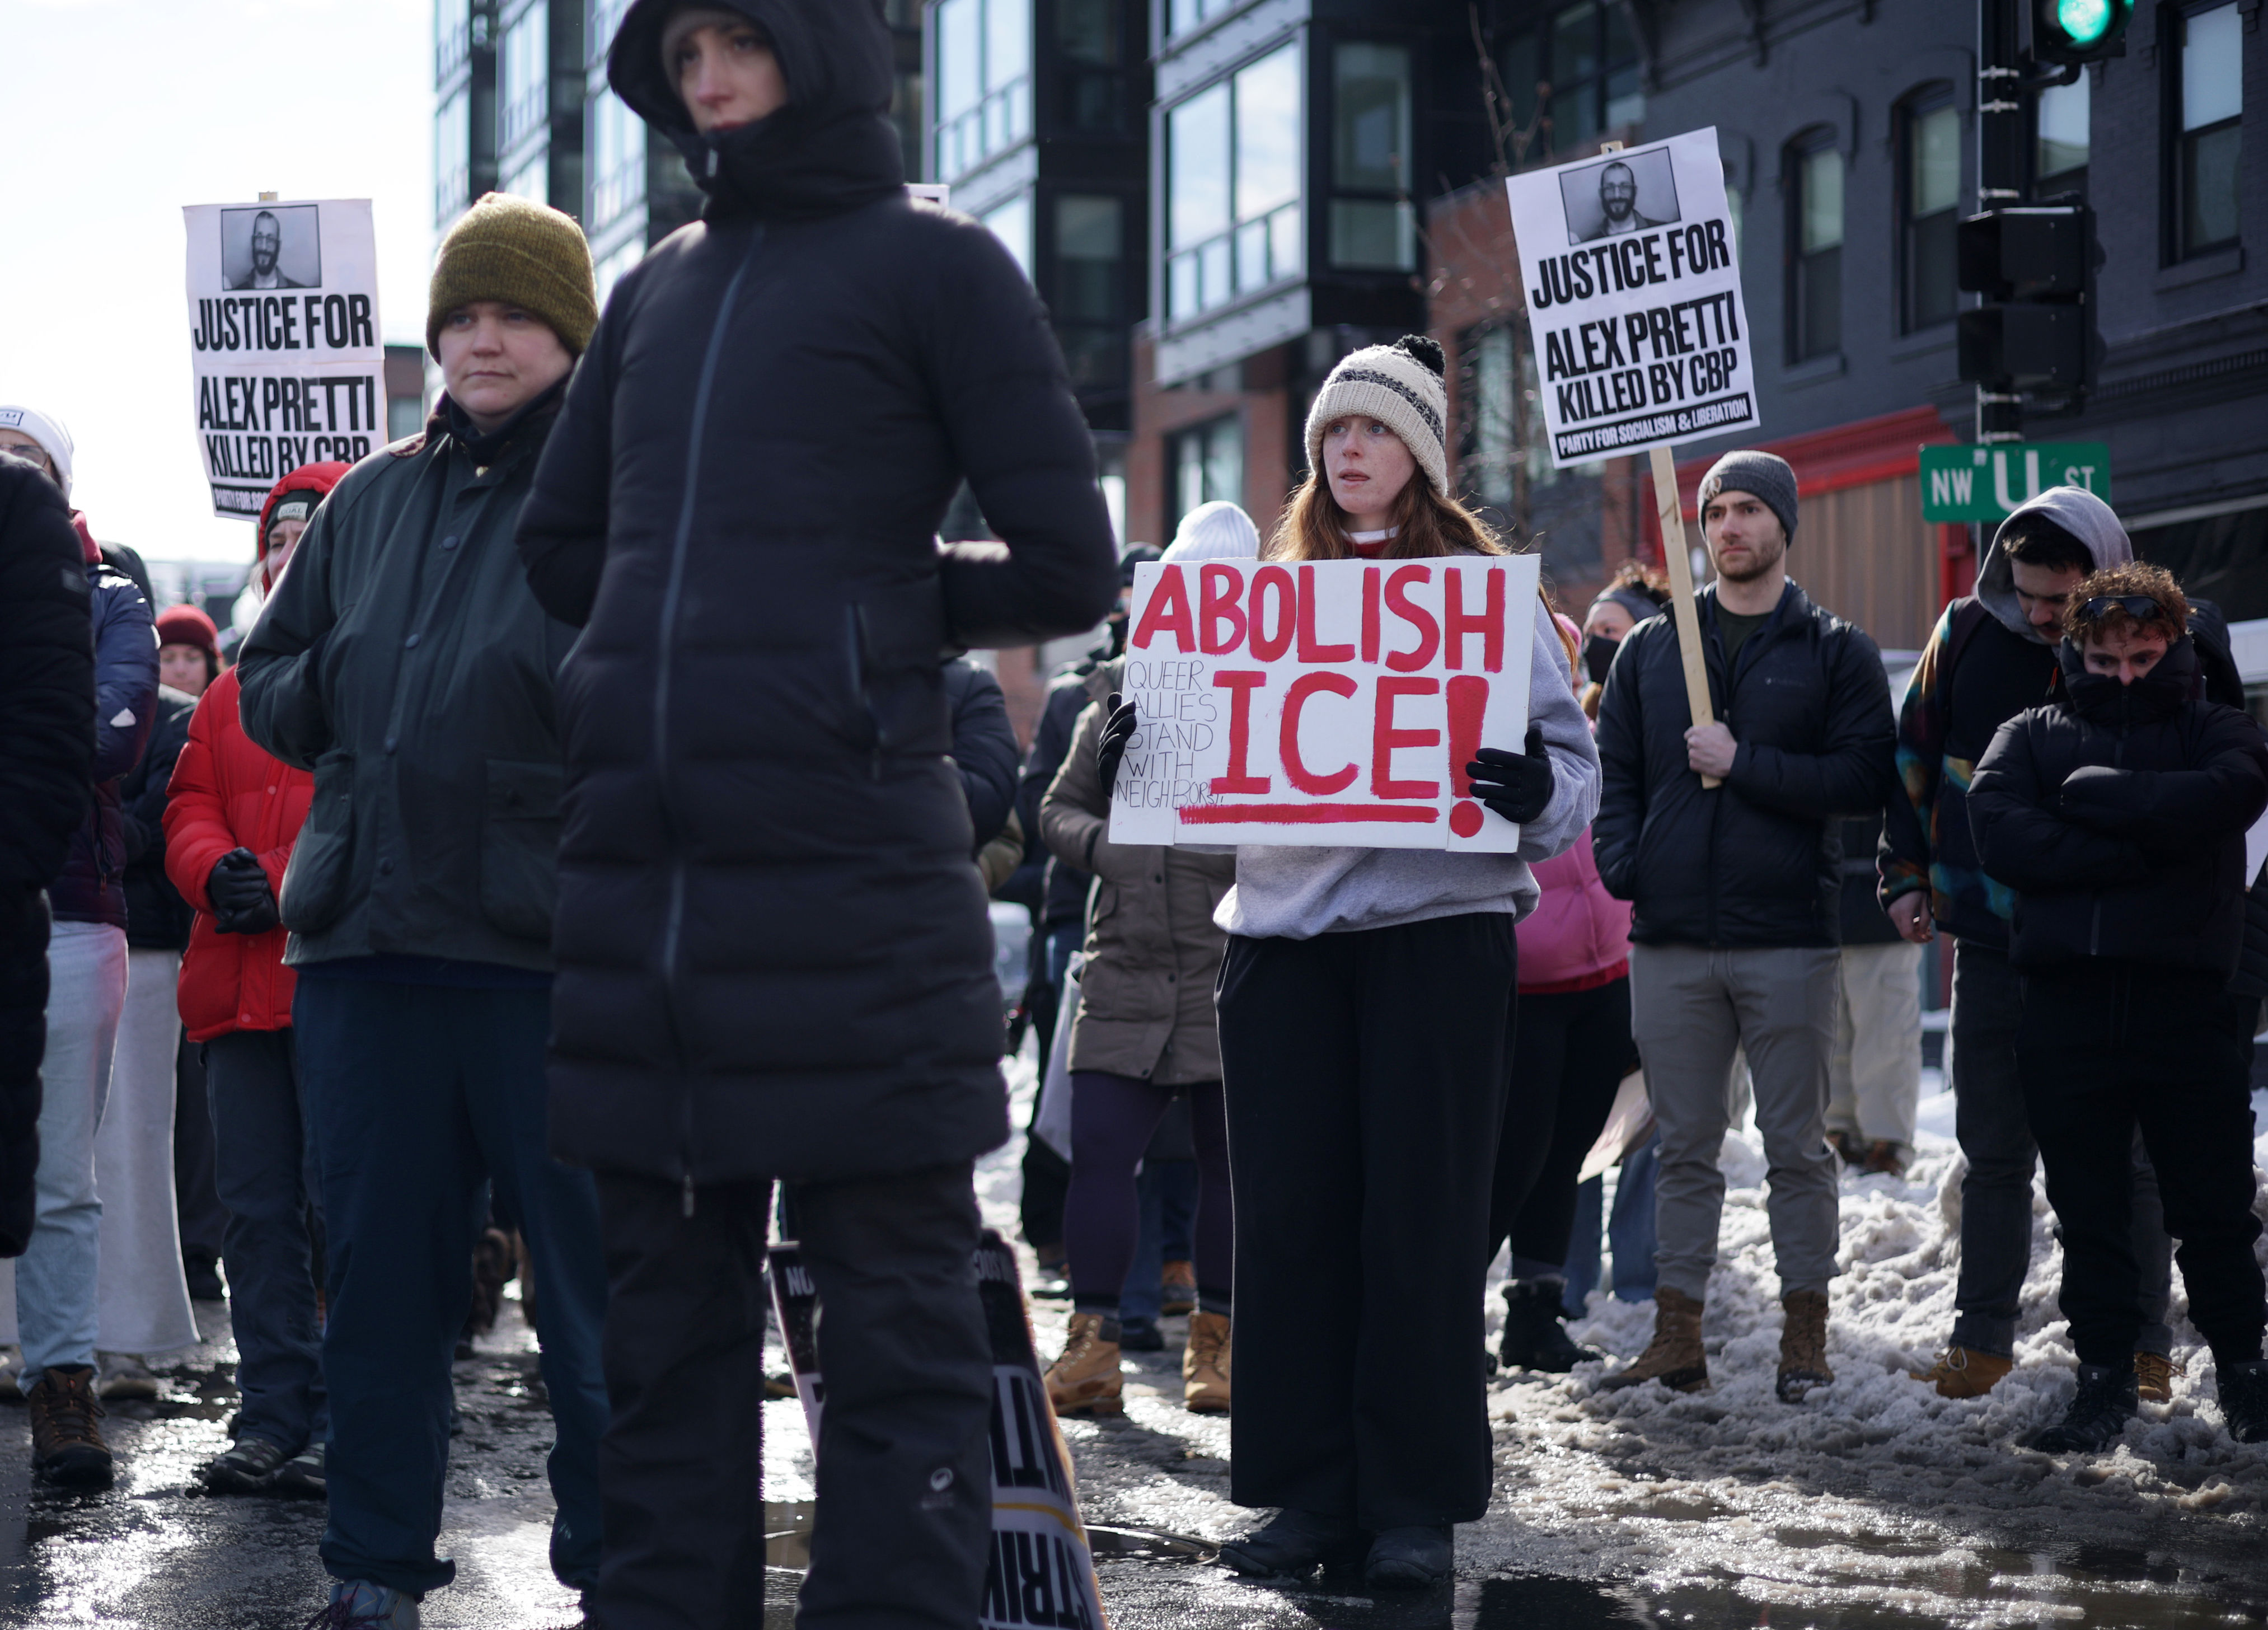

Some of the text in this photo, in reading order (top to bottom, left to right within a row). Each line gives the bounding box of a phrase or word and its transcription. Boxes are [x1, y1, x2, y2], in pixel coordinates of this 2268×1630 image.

[1532, 219, 1730, 310] JUSTICE FOR
[194, 294, 374, 351] JUSTICE FOR
[1547, 291, 1740, 382] ALEX PRETTI
[200, 376, 376, 431] ALEX PRETTI
[1556, 348, 1737, 424] KILLED BY CBP
[1558, 397, 1749, 456] PARTY FOR SOCIALISM & LIBERATION
[206, 434, 274, 479] KILLED
[278, 436, 308, 476] BY
[1931, 468, 1973, 506] NW
[1993, 450, 2040, 513] U
[236, 490, 252, 510] FOR
[1132, 564, 1506, 673] ABOLISH
[1128, 660, 1204, 691] QUEER
[1133, 692, 1217, 722] ALLIES
[1124, 751, 1194, 780] WITH
[1126, 723, 1213, 751] STAND
[1210, 670, 1490, 839] ICE!
